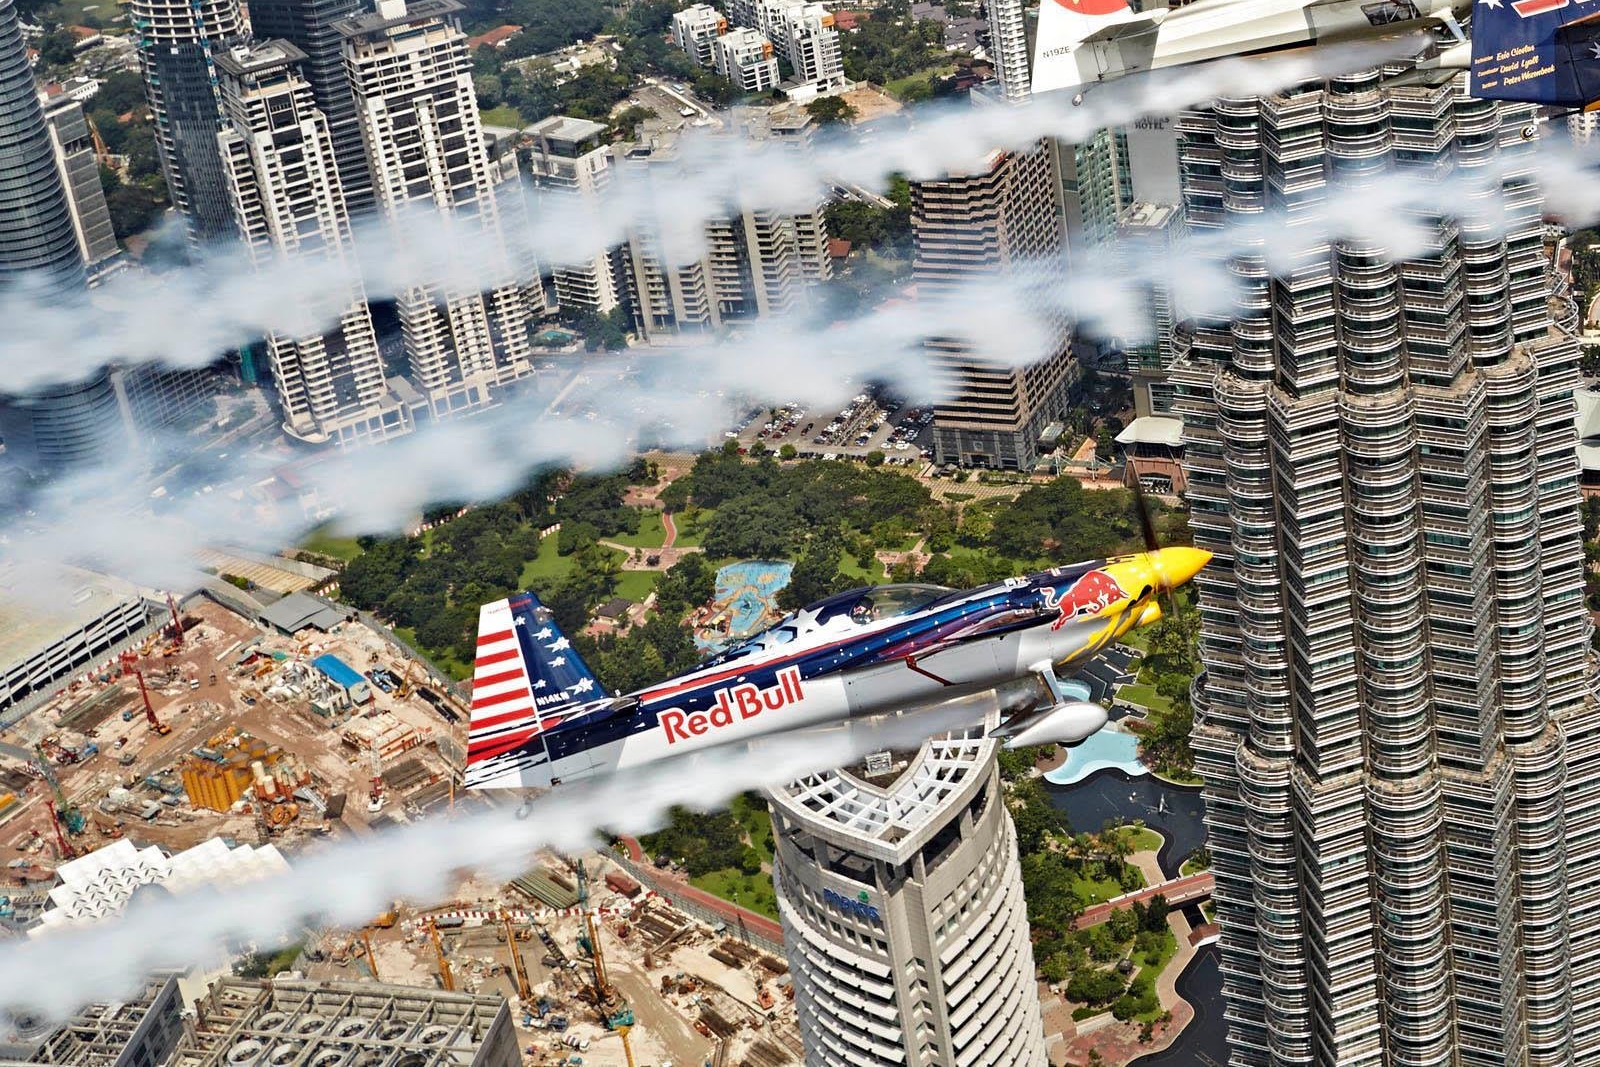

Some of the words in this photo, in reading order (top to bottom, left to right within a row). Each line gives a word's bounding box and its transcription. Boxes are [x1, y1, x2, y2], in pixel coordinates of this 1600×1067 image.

[1043, 46, 1071, 58] N19ZE
[1135, 122, 1164, 130] HOTEL
[535, 691, 570, 706] N14KN
[660, 692, 734, 745] Red
[734, 669, 805, 721] Bull
